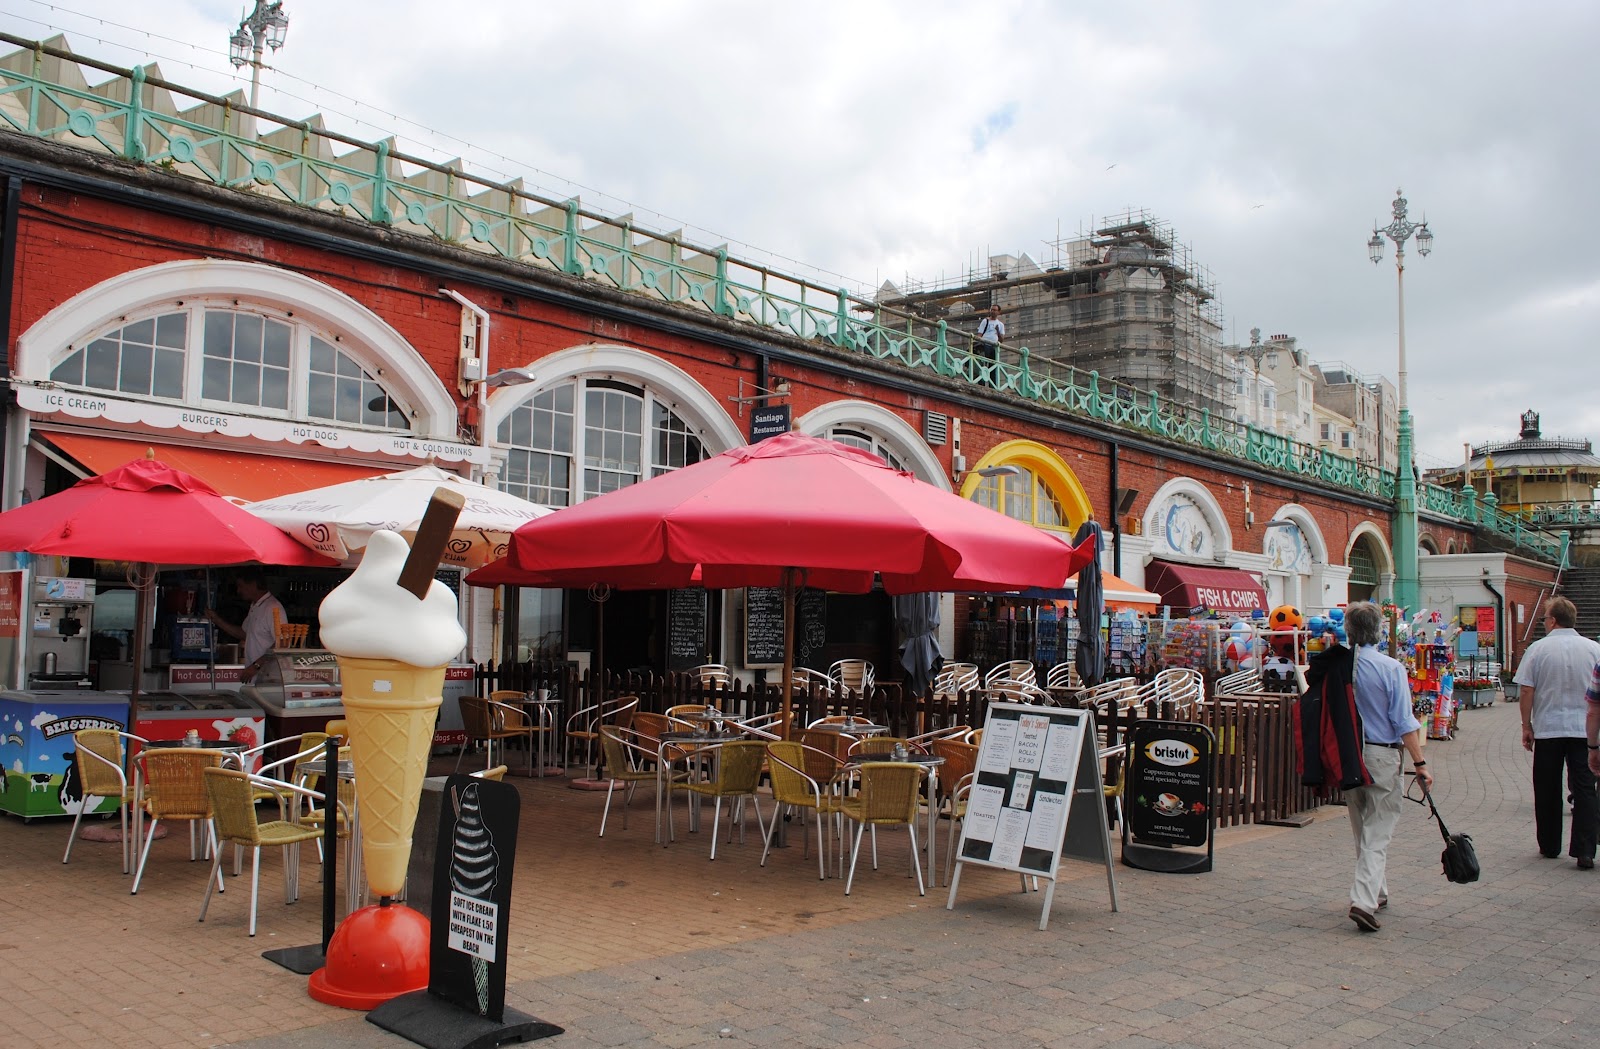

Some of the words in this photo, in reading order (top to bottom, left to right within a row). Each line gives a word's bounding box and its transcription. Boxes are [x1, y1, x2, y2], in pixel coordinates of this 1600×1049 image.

[46, 394, 64, 406] ICE
[68, 398, 107, 411] CREAM
[182, 413, 228, 427] BURGERS
[755, 414, 784, 423] Santiago
[293, 427, 312, 438] HOT
[315, 430, 338, 441] DOGS
[753, 425, 785, 434] Restaurant
[393, 440, 410, 449] HOT
[413, 443, 420, 451] &
[422, 443, 443, 454] COLD
[444, 446, 473, 457] DRINKS
[461, 504, 540, 520] AGNUM
[1196, 587, 1221, 607] FISH
[1222, 589, 1231, 608] &
[1231, 590, 1261, 608] CHIPS
[184, 629, 204, 640] SLUSH
[296, 654, 337, 668] Heaven
[177, 670, 193, 680] hot
[195, 670, 238, 680] choolate
[450, 669, 468, 677] latte
[434, 733, 450, 743] dogs
[1018, 741, 1039, 749] BACON
[1154, 746, 1189, 760] bristot
[1177, 771, 1200, 779] Espresso
[453, 896, 466, 909] SOFT
[465, 900, 475, 912] ICE
[475, 903, 494, 917] CREAM
[452, 909, 466, 923] WITH
[466, 914, 481, 928] FLAKE
[450, 922, 476, 939] CHEAPEST
[475, 930, 483, 942] ON
[484, 933, 494, 945] THE
[462, 939, 480, 954] BEACH
